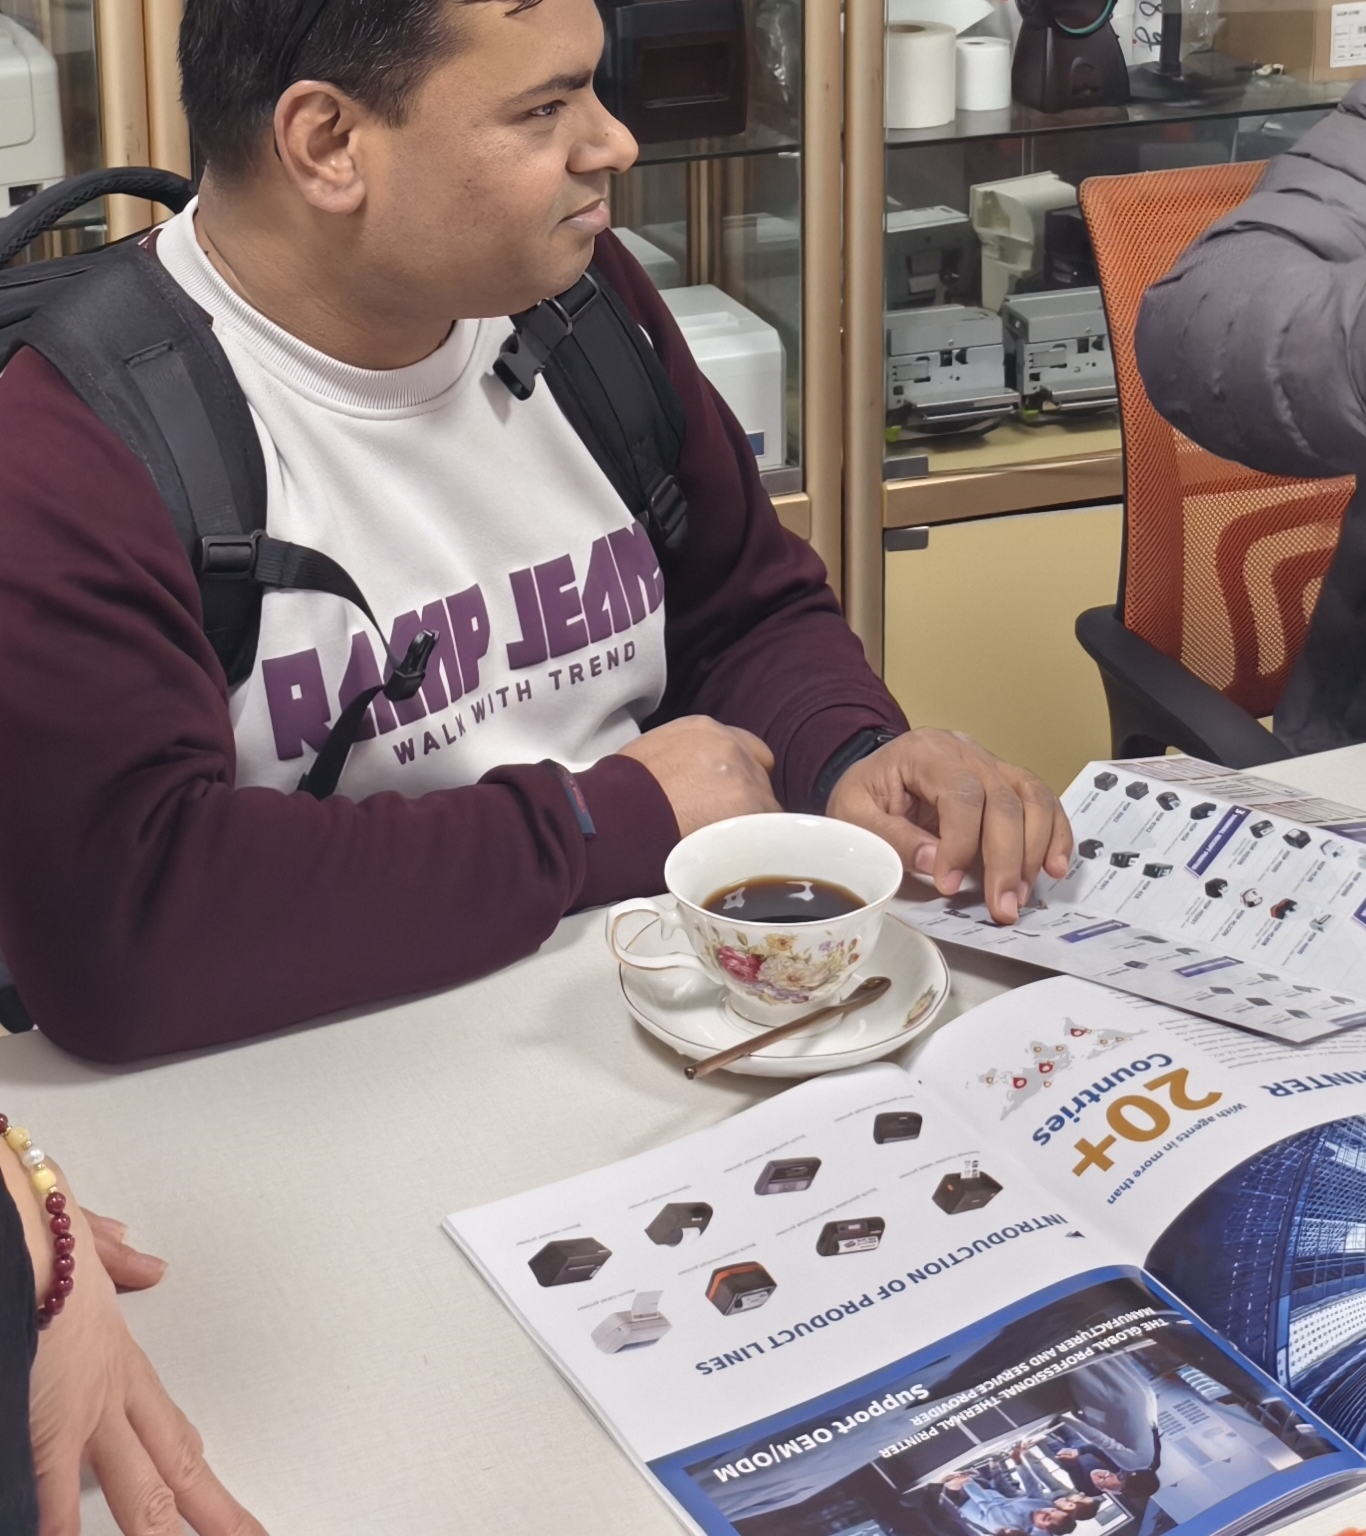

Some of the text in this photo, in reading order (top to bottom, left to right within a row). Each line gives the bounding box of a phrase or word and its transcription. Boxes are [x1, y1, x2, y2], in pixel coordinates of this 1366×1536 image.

[392, 640, 637, 765] WALK WITH TREND
[1032, 1053, 1173, 1146] Countries
[1072, 1067, 1223, 1177] 20+
[1106, 1102, 1248, 1205] With agents in more than
[876, 1278, 907, 1301] OF
[905, 1212, 1069, 1286] INTRODUCTION
[694, 1340, 766, 1376] LINES
[767, 1292, 875, 1351] PRODUCT
[910, 1306, 1157, 1427] MANUFACTURER AND SERVICE PROVIDER
[712, 1382, 931, 1484] Support OEM/ODM
[877, 1316, 1169, 1460] THE GLOBAL PROFESSIONAL THERMAL PRINTER
